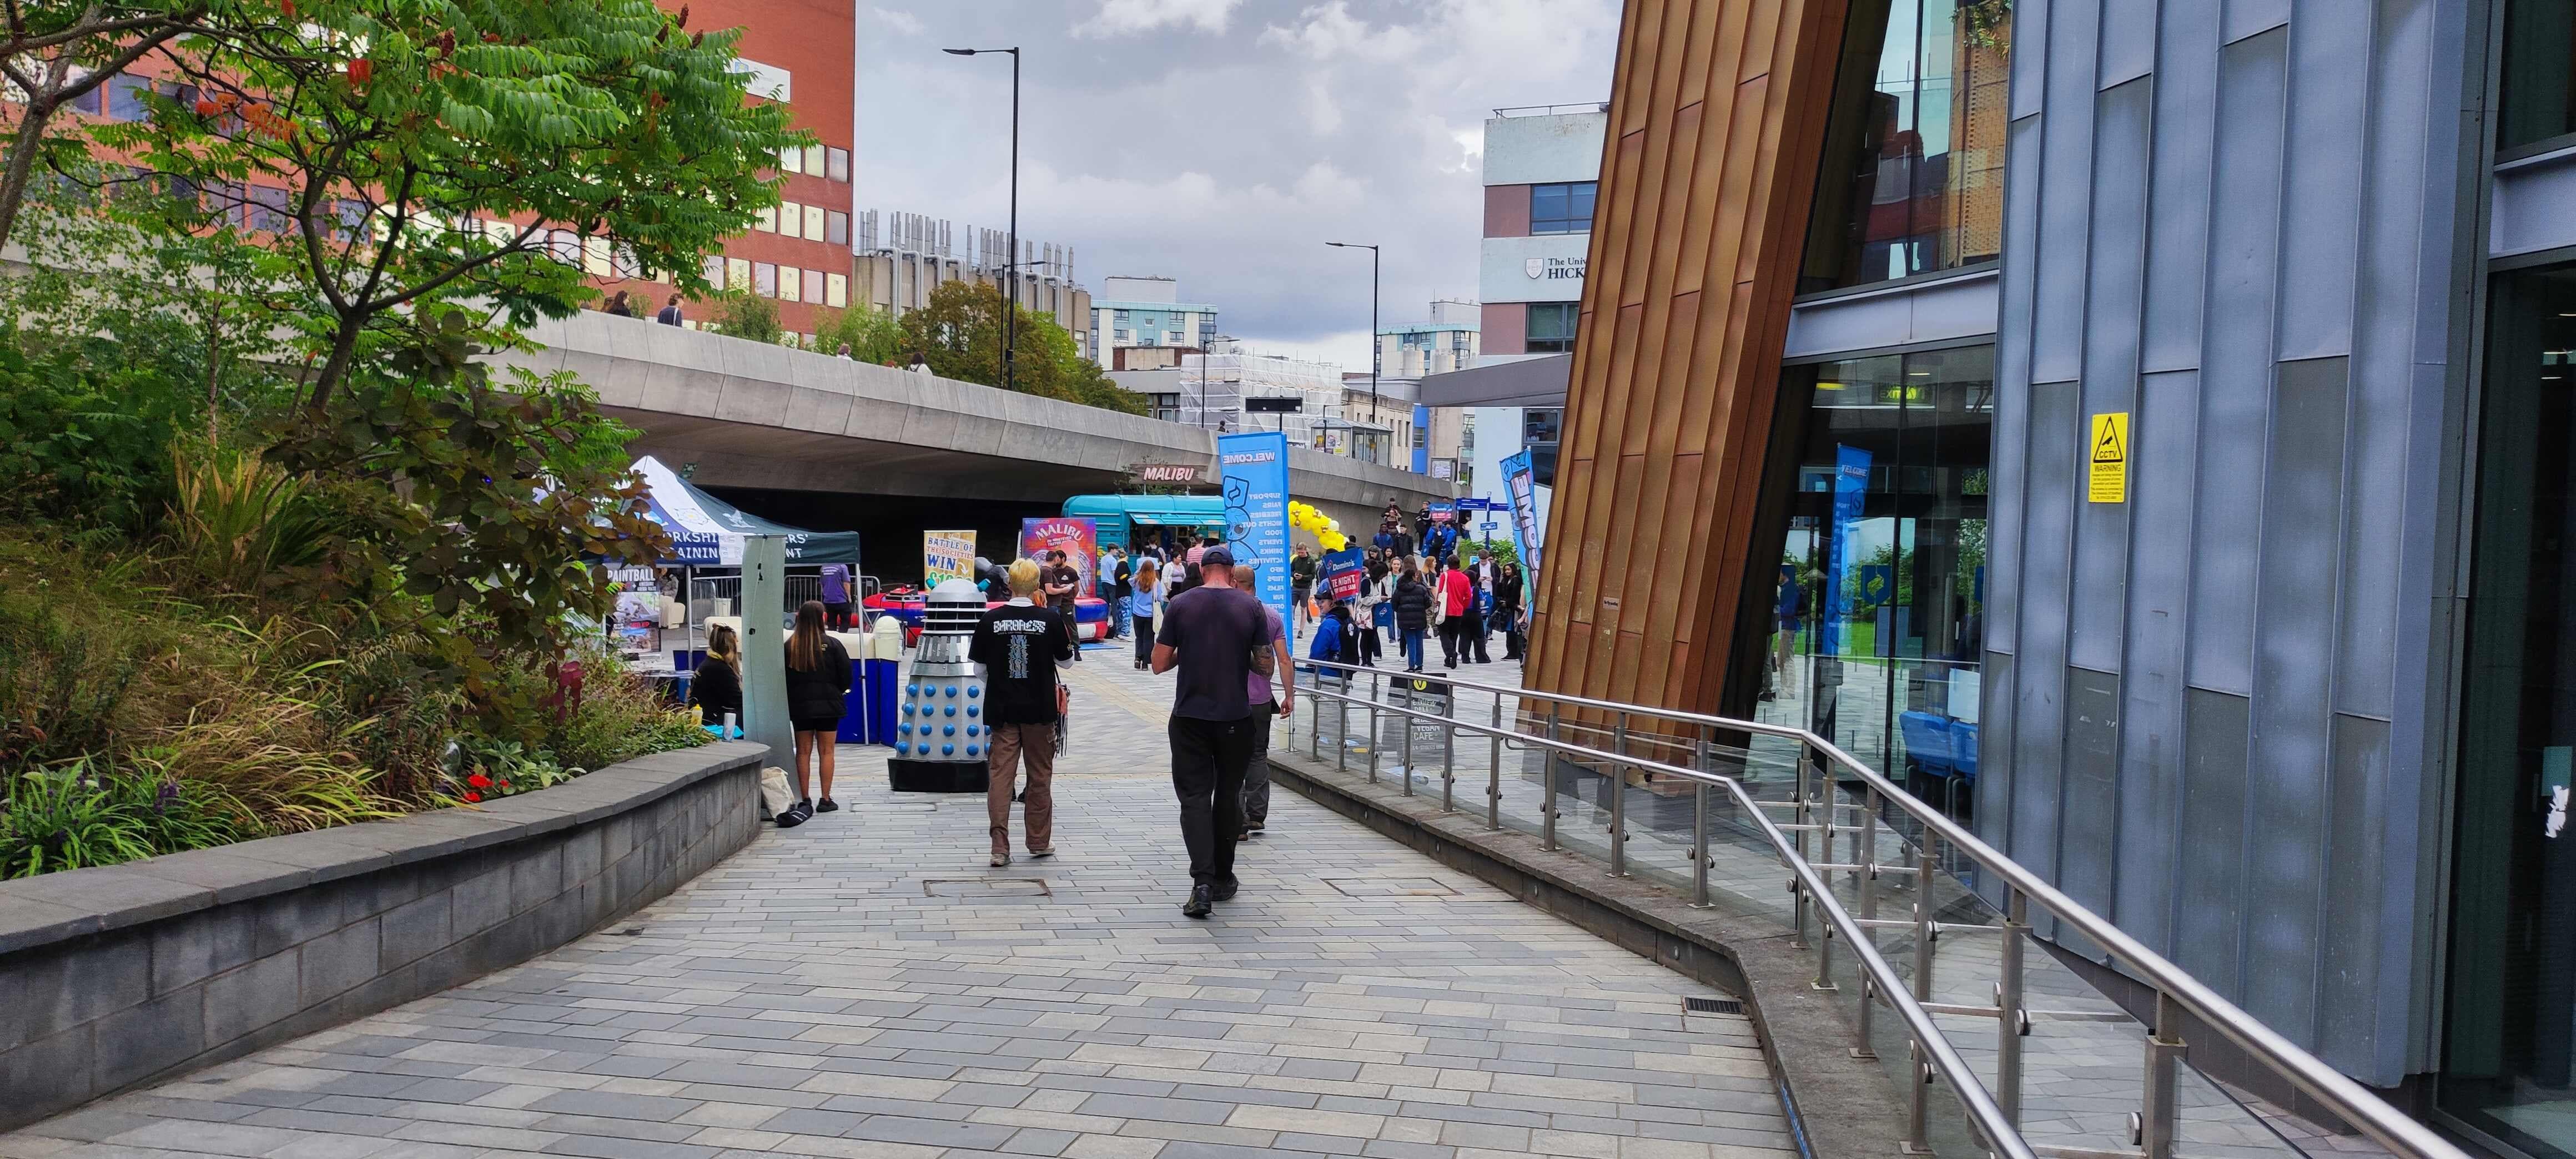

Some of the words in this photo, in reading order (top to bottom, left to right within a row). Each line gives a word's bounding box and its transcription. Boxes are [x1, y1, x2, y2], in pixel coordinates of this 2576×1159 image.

[1548, 258, 1564, 266] The
[1144, 467, 1195, 481] MALIBU
[1035, 523, 1084, 541] MALIBU
[928, 537, 960, 550] BATTLE
[963, 543, 974, 552] OF
[942, 548, 974, 560] SOCIETIES
[927, 553, 956, 571] WIN
[1332, 559, 1355, 571] Domino's
[607, 567, 656, 582] PAINTBALL
[1338, 575, 1355, 586] NIGHT
